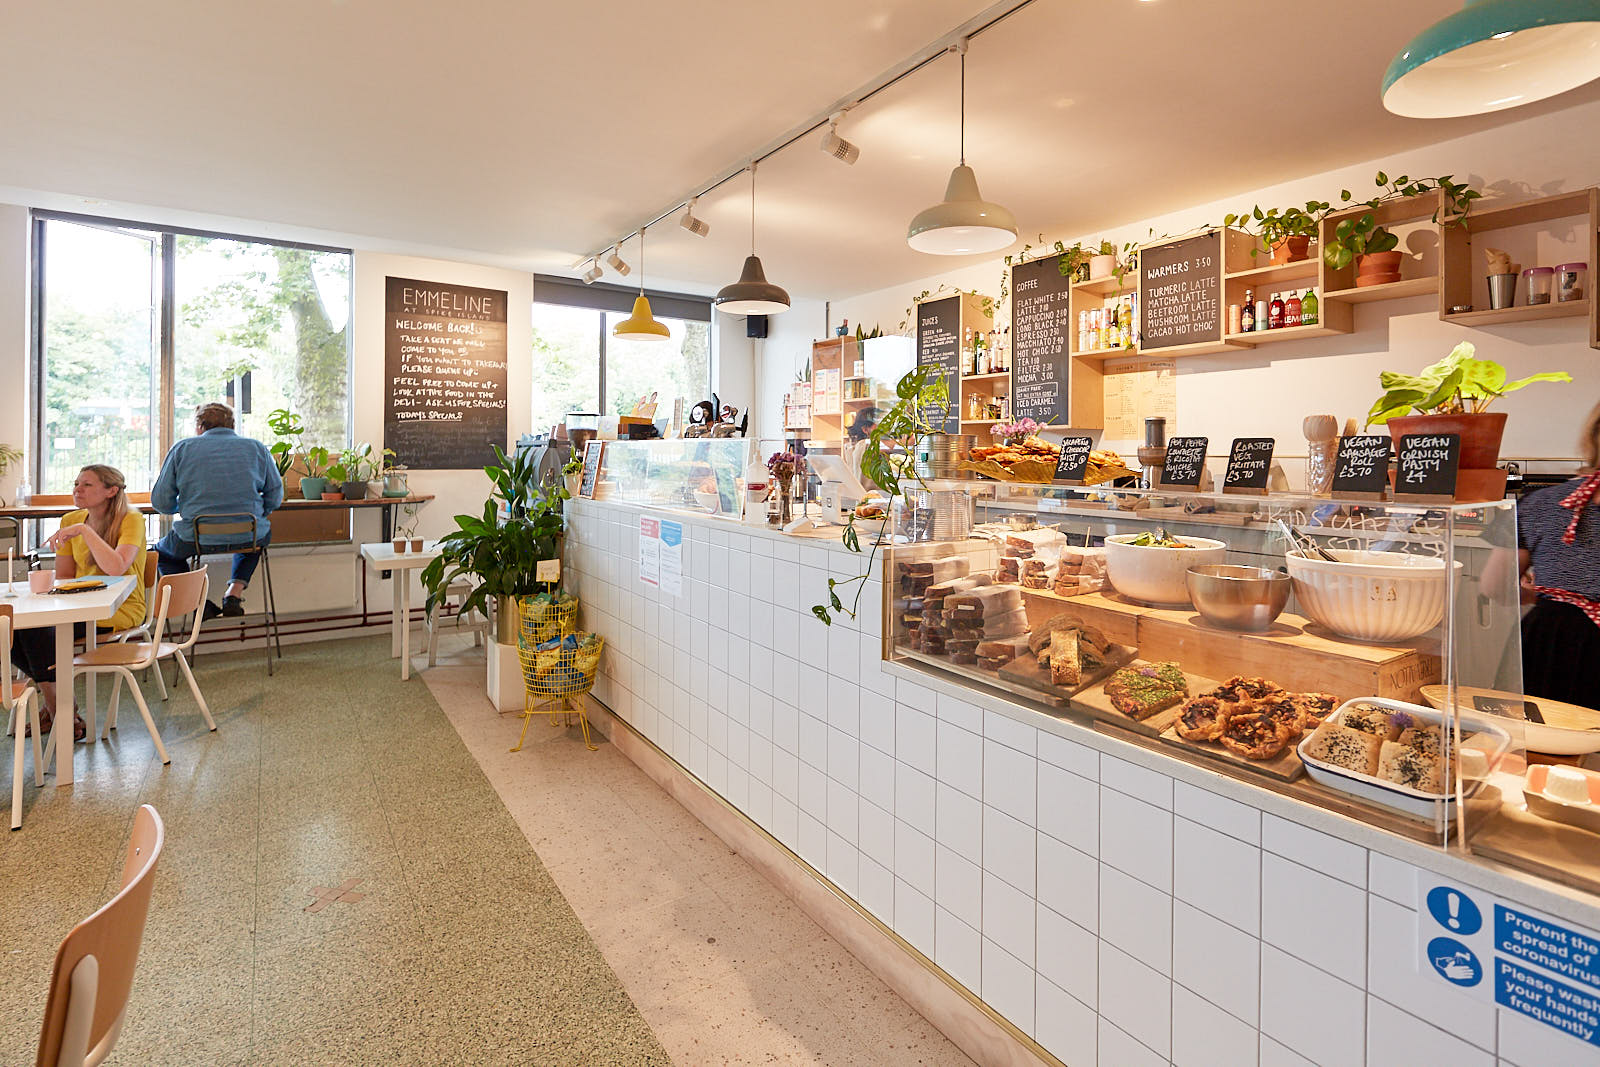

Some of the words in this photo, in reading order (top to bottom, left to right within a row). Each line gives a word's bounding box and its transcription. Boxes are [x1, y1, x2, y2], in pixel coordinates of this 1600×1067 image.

[1148, 261, 1189, 280] WARMERS
[1016, 279, 1038, 292] COFFEE
[1148, 282, 1187, 298] TURMERIC
[1190, 276, 1216, 291] LATTE
[403, 288, 492, 314] EMMELINE
[1017, 298, 1033, 308] FLAT
[1034, 293, 1054, 304] WHITE
[1148, 295, 1179, 309] MATCHA
[1181, 290, 1206, 303] LATTE
[1017, 305, 1036, 317] LATTE
[1148, 304, 1188, 319] BEETROOT
[1191, 299, 1216, 311] LATTE
[1017, 311, 1054, 326] CAPPUCCINO
[1148, 314, 1189, 328] MUSHROOM
[1192, 310, 1217, 322] LATTE
[395, 320, 442, 331] WELCOME
[447, 322, 475, 335] BACK!
[1017, 324, 1032, 334] LONG
[1035, 320, 1054, 330] BLACK
[1148, 327, 1173, 338] CACAO
[400, 335, 423, 343] TAKE
[1016, 330, 1048, 341] ESPRESSO
[1016, 337, 1052, 349] MACCHIATO
[438, 347, 455, 355] YOU
[1017, 350, 1029, 358] HOT
[1032, 346, 1049, 356] CHOC
[401, 354, 412, 362] IF
[416, 355, 433, 364] YOU
[1018, 358, 1029, 366] TEA
[401, 364, 432, 373] PLEASE
[1018, 365, 1040, 375] FILTER
[393, 377, 419, 386] FEEL
[456, 380, 479, 388] COME
[481, 381, 492, 389] UP
[1018, 374, 1037, 383] MOCHA
[393, 388, 414, 396] LOOK
[416, 388, 426, 396] AT
[445, 390, 464, 398] FOOD
[425, 399, 444, 407] ASK
[457, 400, 472, 408] FOR
[1017, 400, 1030, 408] ICED
[1031, 398, 1056, 407] CARAMEL
[428, 411, 463, 419] SPECIALS
[1017, 409, 1033, 417] LATTE
[1235, 442, 1274, 452] ROASTED
[1344, 437, 1383, 448] VEGAN
[1406, 437, 1450, 449] VEGAN
[1060, 454, 1079, 462] TWIST
[1173, 455, 1201, 463] RICOTTA
[1233, 452, 1252, 461] VEG
[1340, 448, 1387, 459] SAUSAGE
[1401, 449, 1449, 460] CORNISH
[1166, 463, 1192, 471] QUICHE
[1229, 460, 1266, 470] FRITTATA
[1351, 457, 1375, 467] ROLL
[1402, 459, 1440, 471] PASTY
[1405, 471, 1427, 483] £4
[1268, 504, 1324, 528] KIDS
[1504, 911, 1567, 944] Prevent
[1571, 936, 1599, 956] the
[1512, 930, 1568, 958] spread
[1573, 954, 1591, 966] of
[1502, 941, 1600, 985] coronavirus
[1501, 963, 1554, 994] Please
[1558, 988, 1600, 1014] wash
[1505, 981, 1542, 1002] your
[1546, 997, 1599, 1027] hands
[1509, 995, 1594, 1040] frequently
